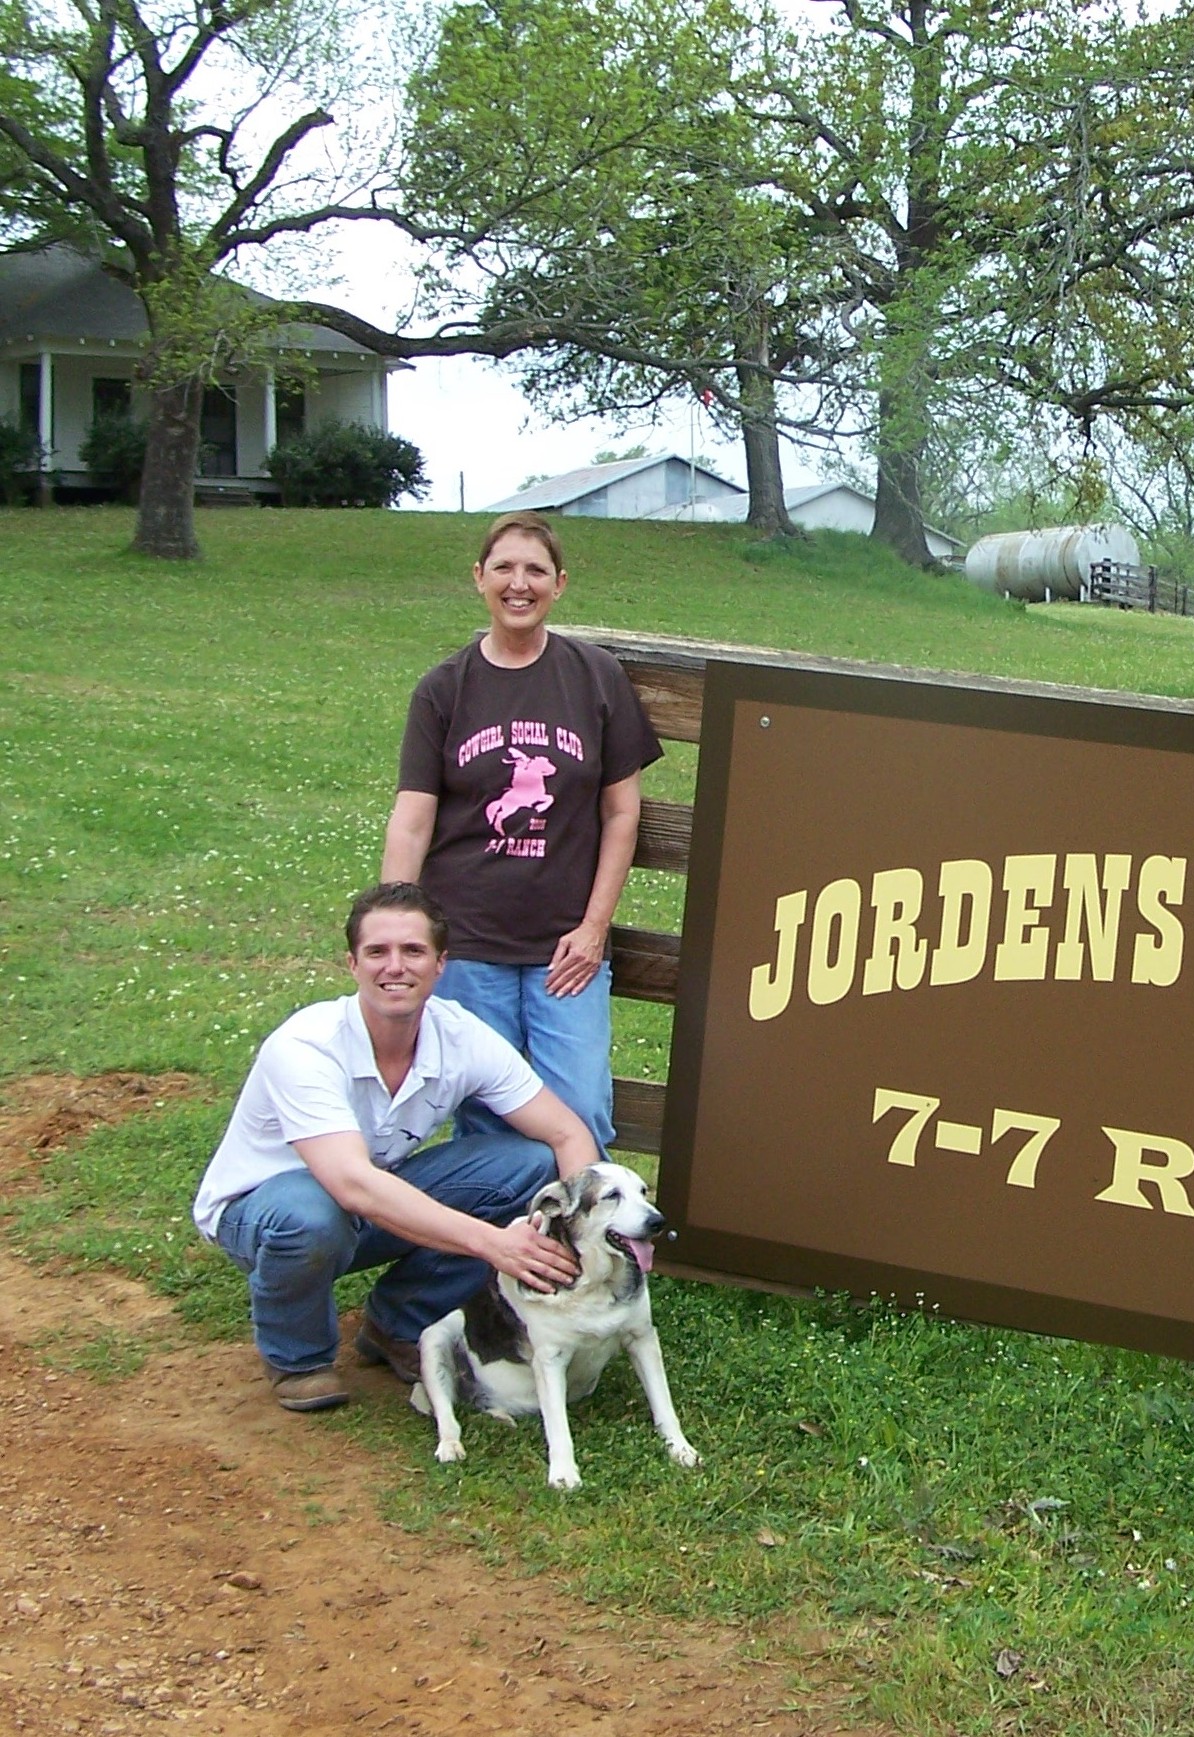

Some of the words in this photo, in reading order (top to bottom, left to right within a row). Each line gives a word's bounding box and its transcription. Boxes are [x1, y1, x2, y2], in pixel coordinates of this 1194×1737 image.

[457, 725, 505, 768] COWGIRL
[511, 720, 550, 747] SOCIAL
[556, 726, 584, 762] CLUB
[506, 837, 547, 858] RANCH
[748, 853, 1187, 1021] JORDENS
[871, 1087, 1062, 1190] 7-7
